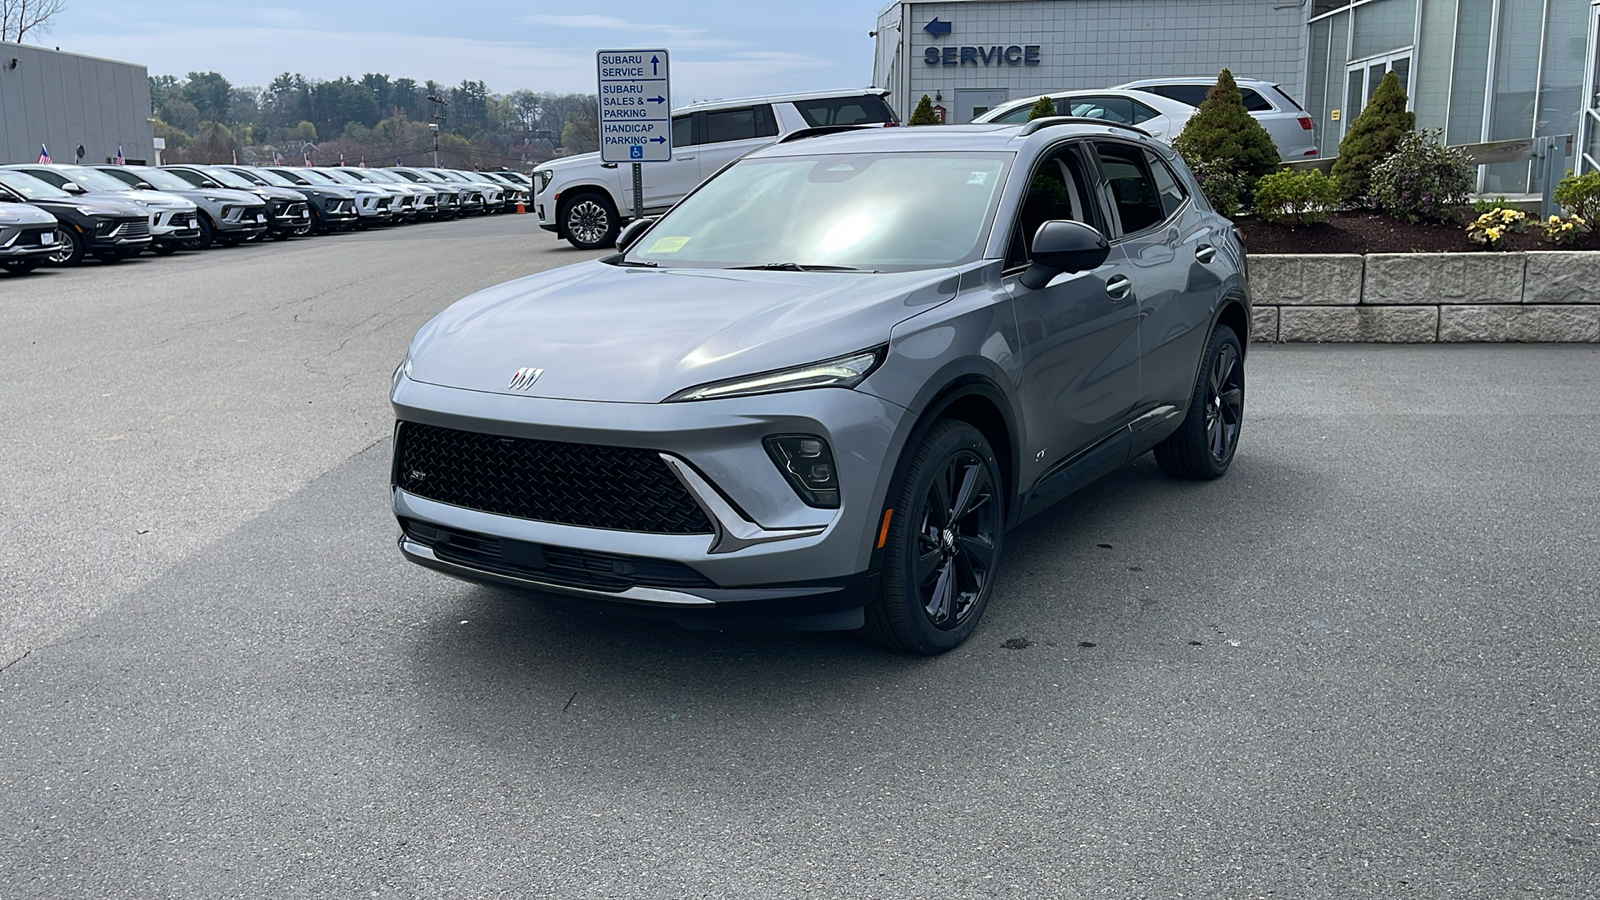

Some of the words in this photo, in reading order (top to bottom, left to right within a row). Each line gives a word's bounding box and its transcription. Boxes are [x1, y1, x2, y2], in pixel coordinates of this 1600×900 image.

[924, 45, 1040, 66] SERVICE
[602, 56, 641, 64] SUBARU
[602, 68, 643, 76] SERVICE
[603, 85, 643, 93] SUBARU
[603, 97, 634, 105] SALES
[638, 97, 644, 105] &
[604, 109, 646, 117] PARKING
[605, 124, 653, 132] HANDICAP
[605, 136, 647, 145] PARKING
